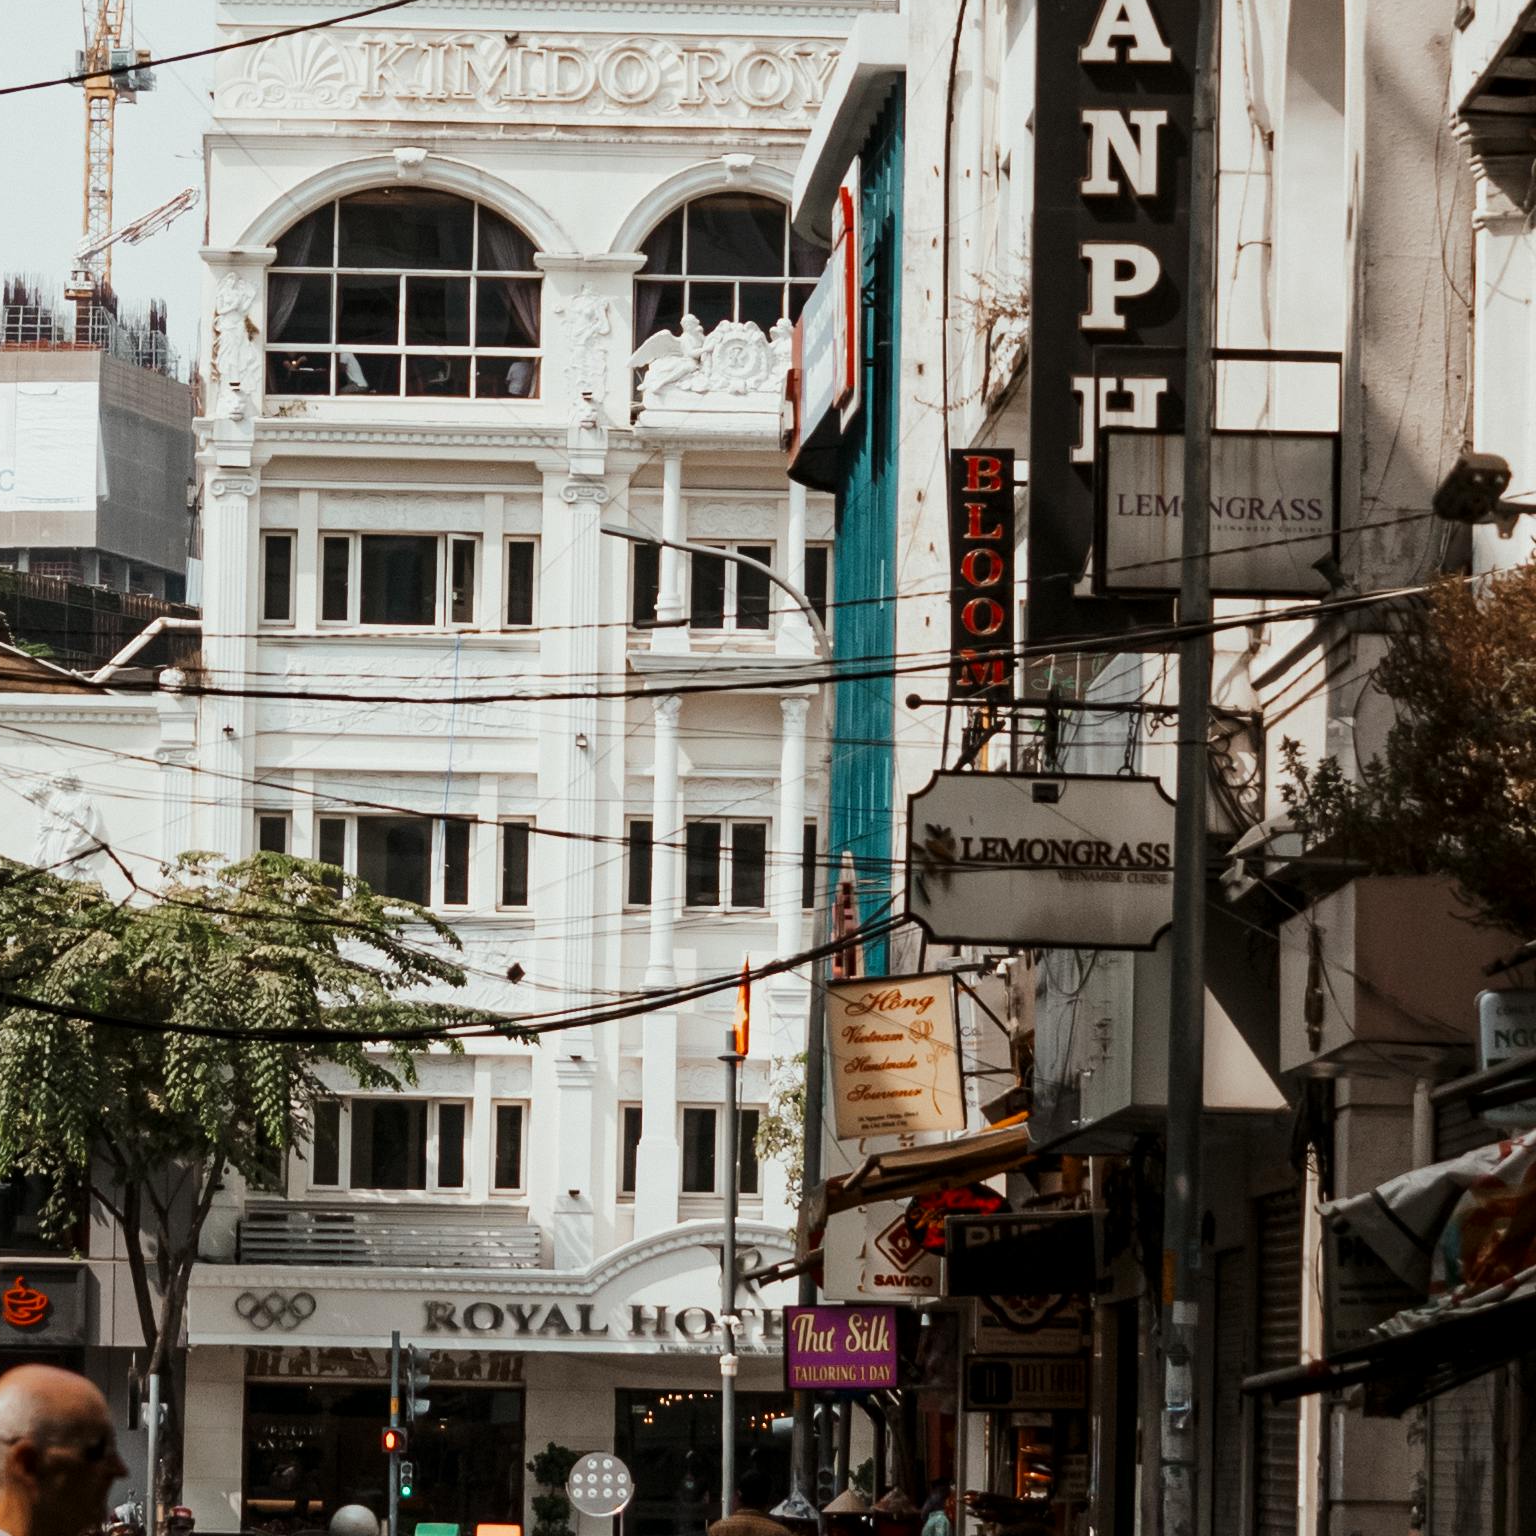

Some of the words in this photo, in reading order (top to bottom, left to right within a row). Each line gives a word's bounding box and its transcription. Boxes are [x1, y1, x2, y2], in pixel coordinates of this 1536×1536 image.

[957, 455, 1009, 686] BLOOM
[960, 837, 1170, 866] LEMONGRASS
[874, 1274, 933, 1288] SAVICO
[424, 1300, 608, 1335] ROYAL
[845, 1313, 890, 1352] Silk
[794, 1366, 856, 1382] TAILORING
[869, 1366, 890, 1381] DAY
